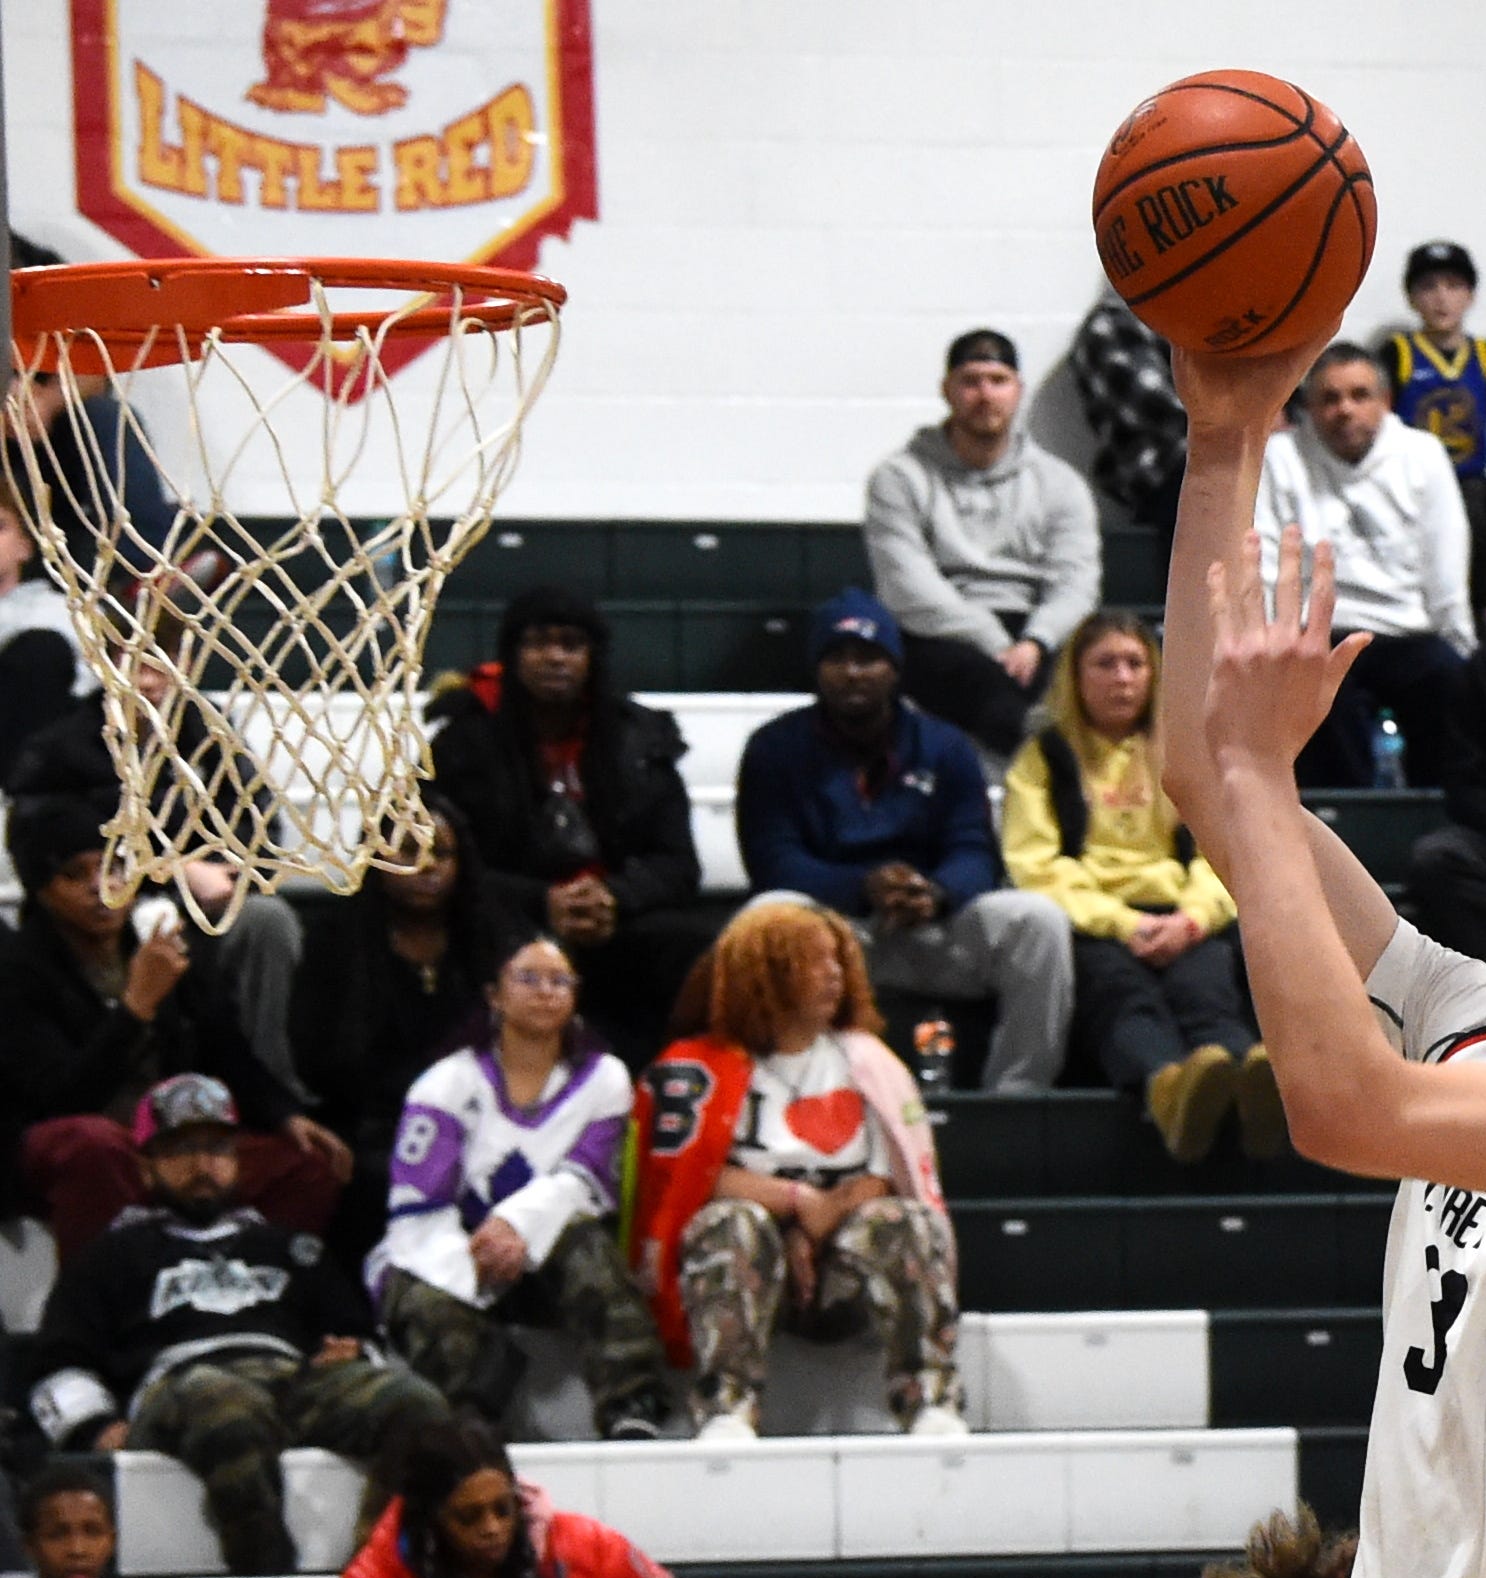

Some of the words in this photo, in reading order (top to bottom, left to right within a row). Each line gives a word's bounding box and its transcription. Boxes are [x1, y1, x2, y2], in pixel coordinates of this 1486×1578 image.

[133, 58, 380, 215] LITTLE
[393, 81, 536, 212] RED
[1135, 174, 1240, 255] ROCK
[399, 1115, 438, 1167] 8
[640, 1058, 716, 1158] B
